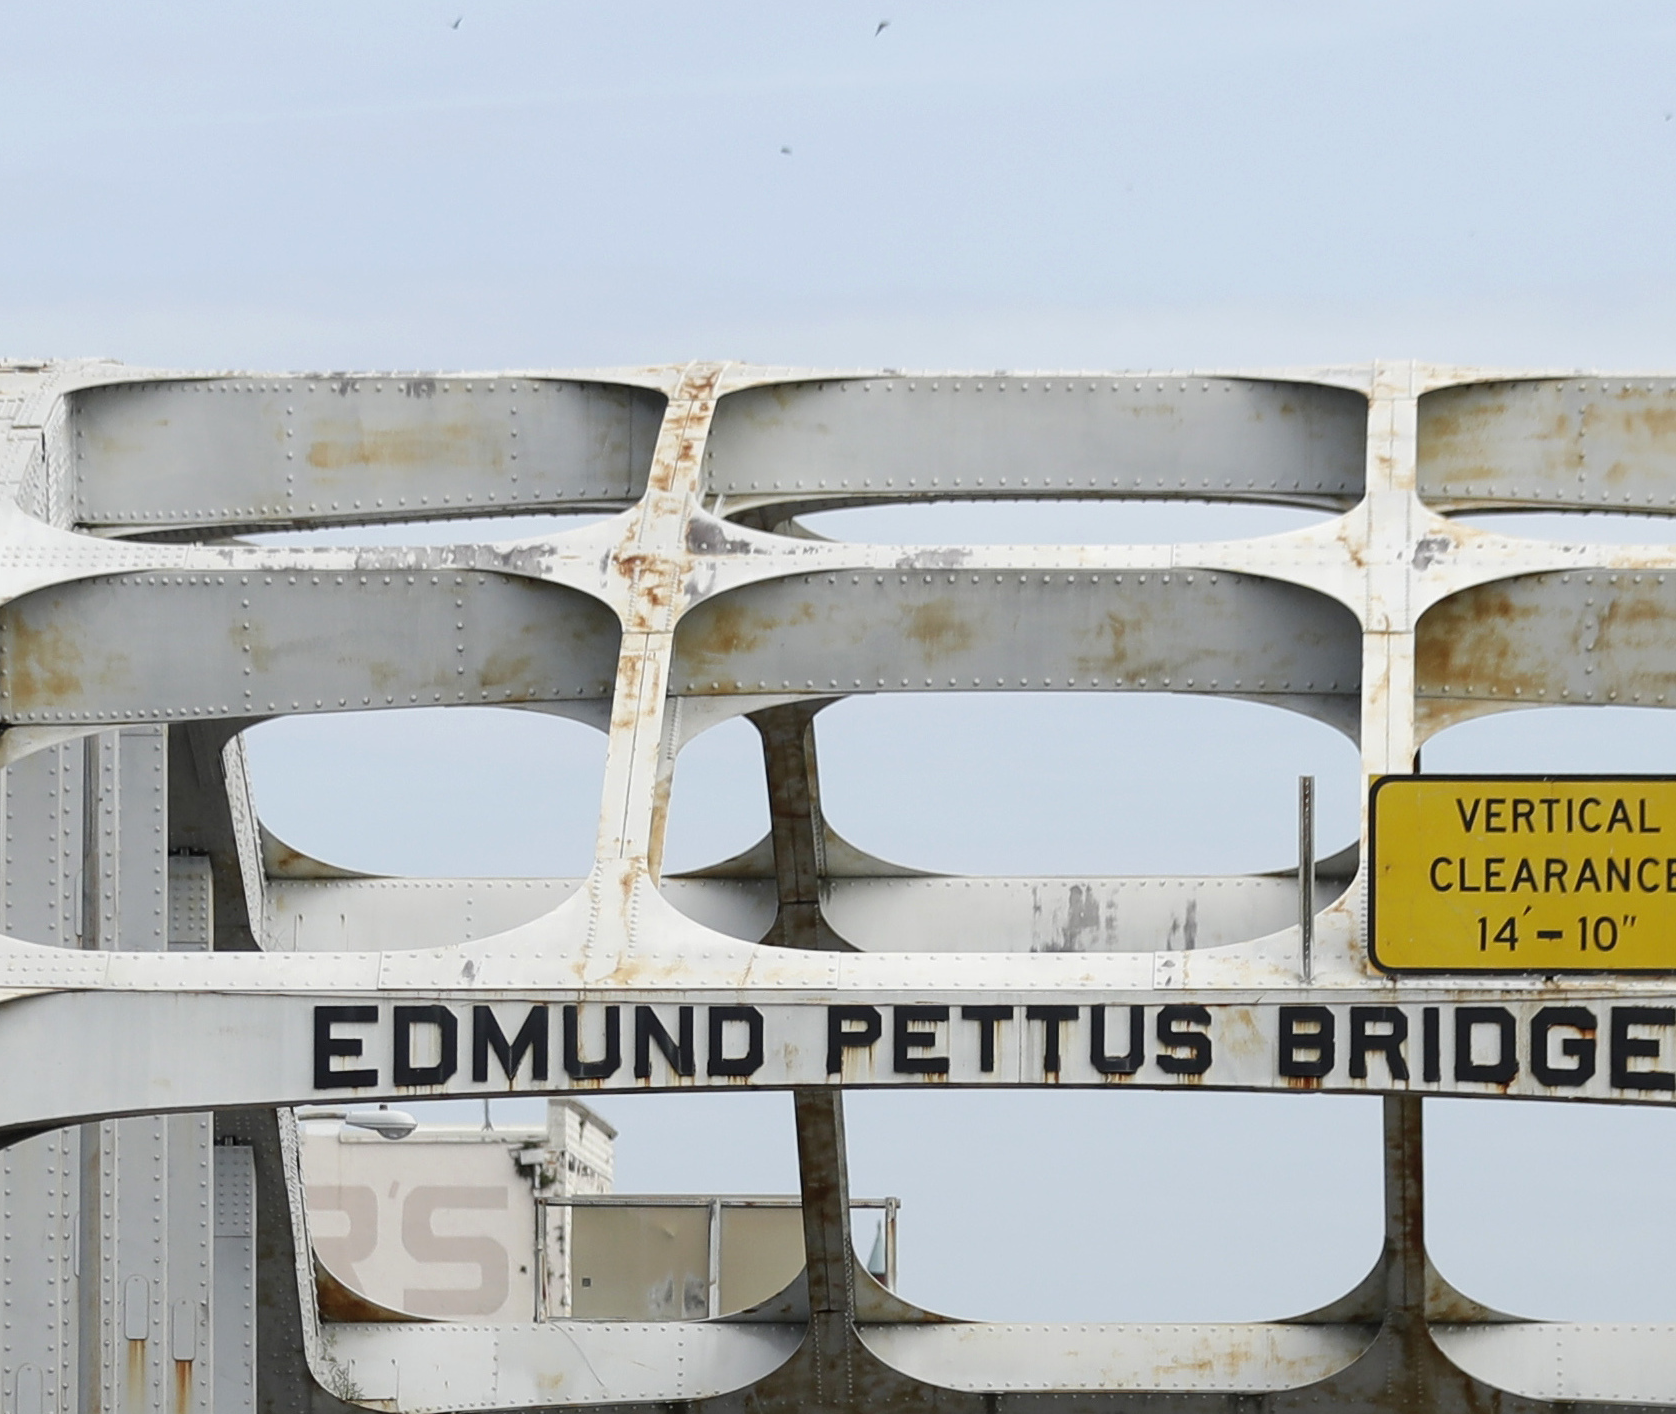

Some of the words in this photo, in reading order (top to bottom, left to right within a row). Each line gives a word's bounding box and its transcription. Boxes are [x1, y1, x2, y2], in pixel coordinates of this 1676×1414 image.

[1455, 797, 1661, 834] VERTICAL
[313, 1004, 765, 1089] EDMUND
[825, 1004, 1213, 1078] PETTUS
